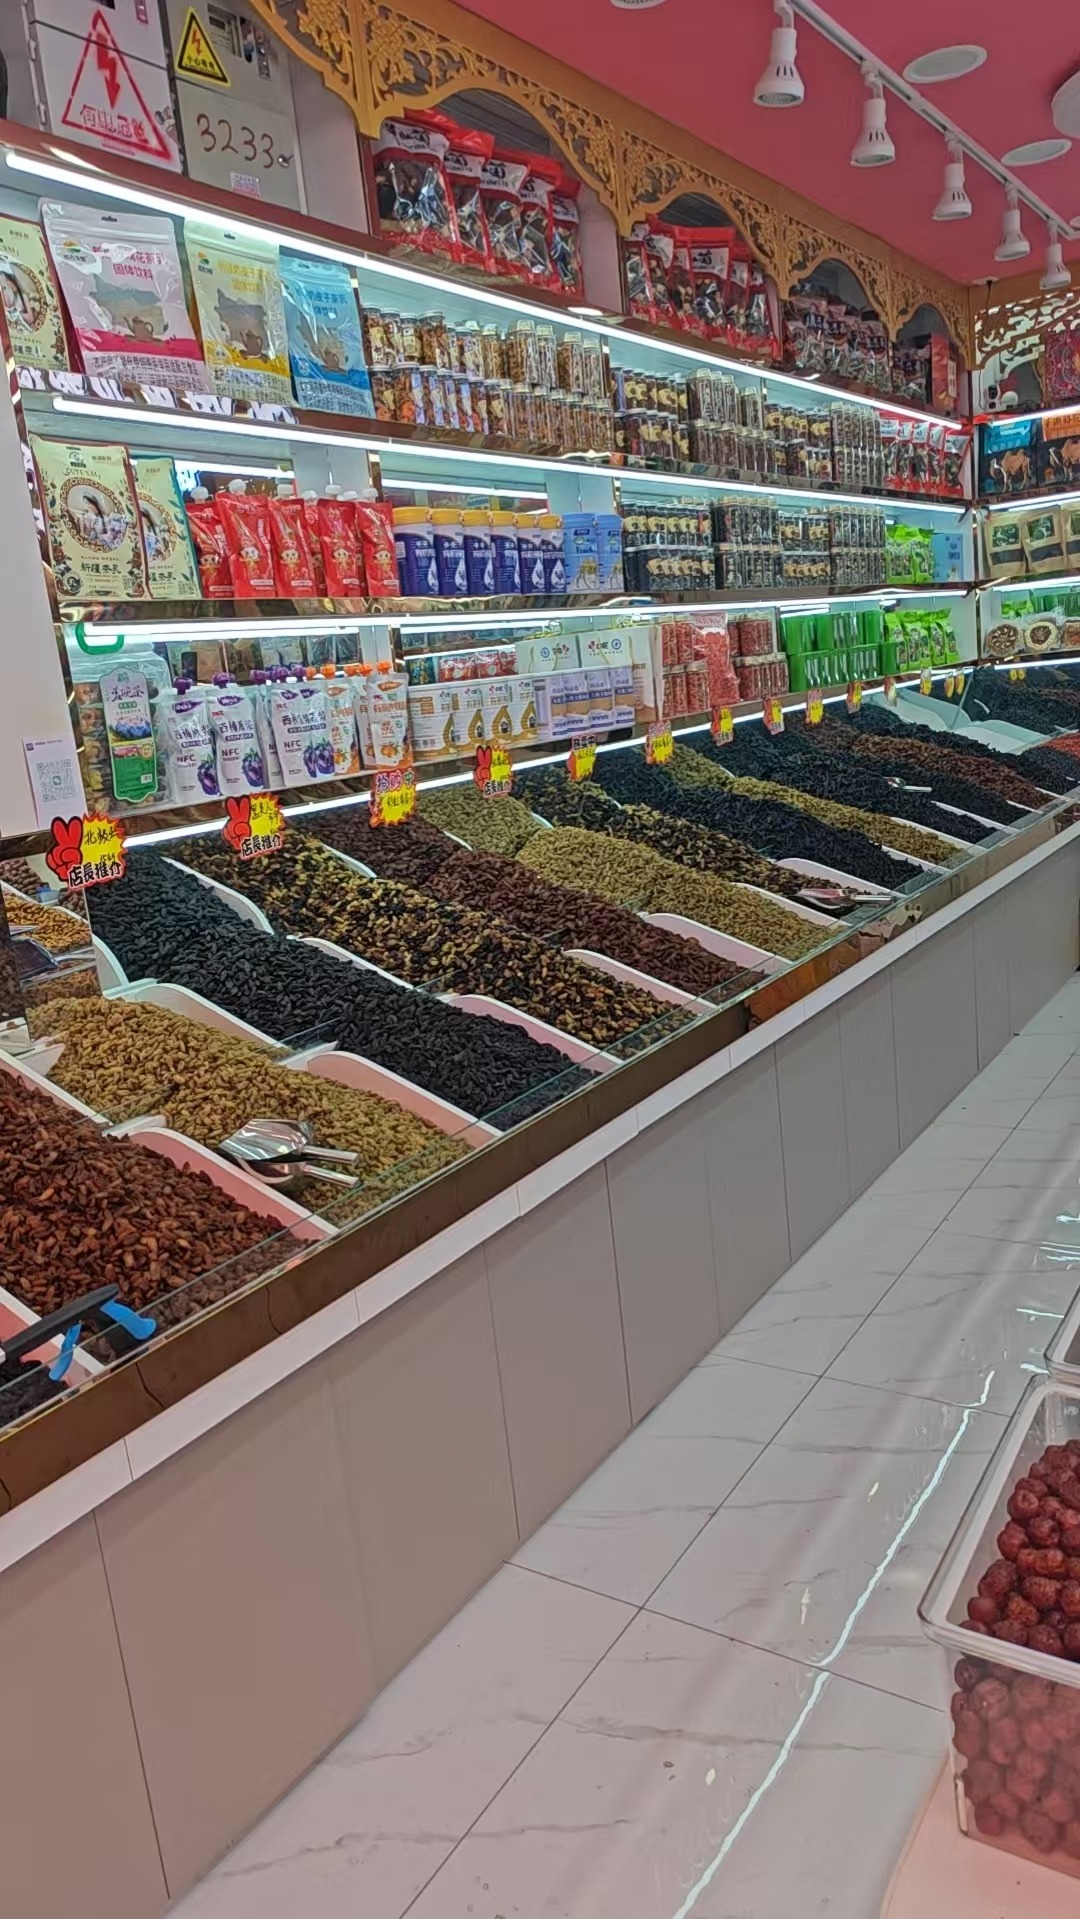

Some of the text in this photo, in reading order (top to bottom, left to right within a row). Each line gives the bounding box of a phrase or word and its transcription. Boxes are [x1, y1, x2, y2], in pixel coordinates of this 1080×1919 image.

[197, 114, 274, 169] 3233
[284, 740, 301, 748] NFC
[221, 748, 240, 757] NFC
[176, 754, 196, 763] NFC
[68, 861, 122, 887] 店長推介
